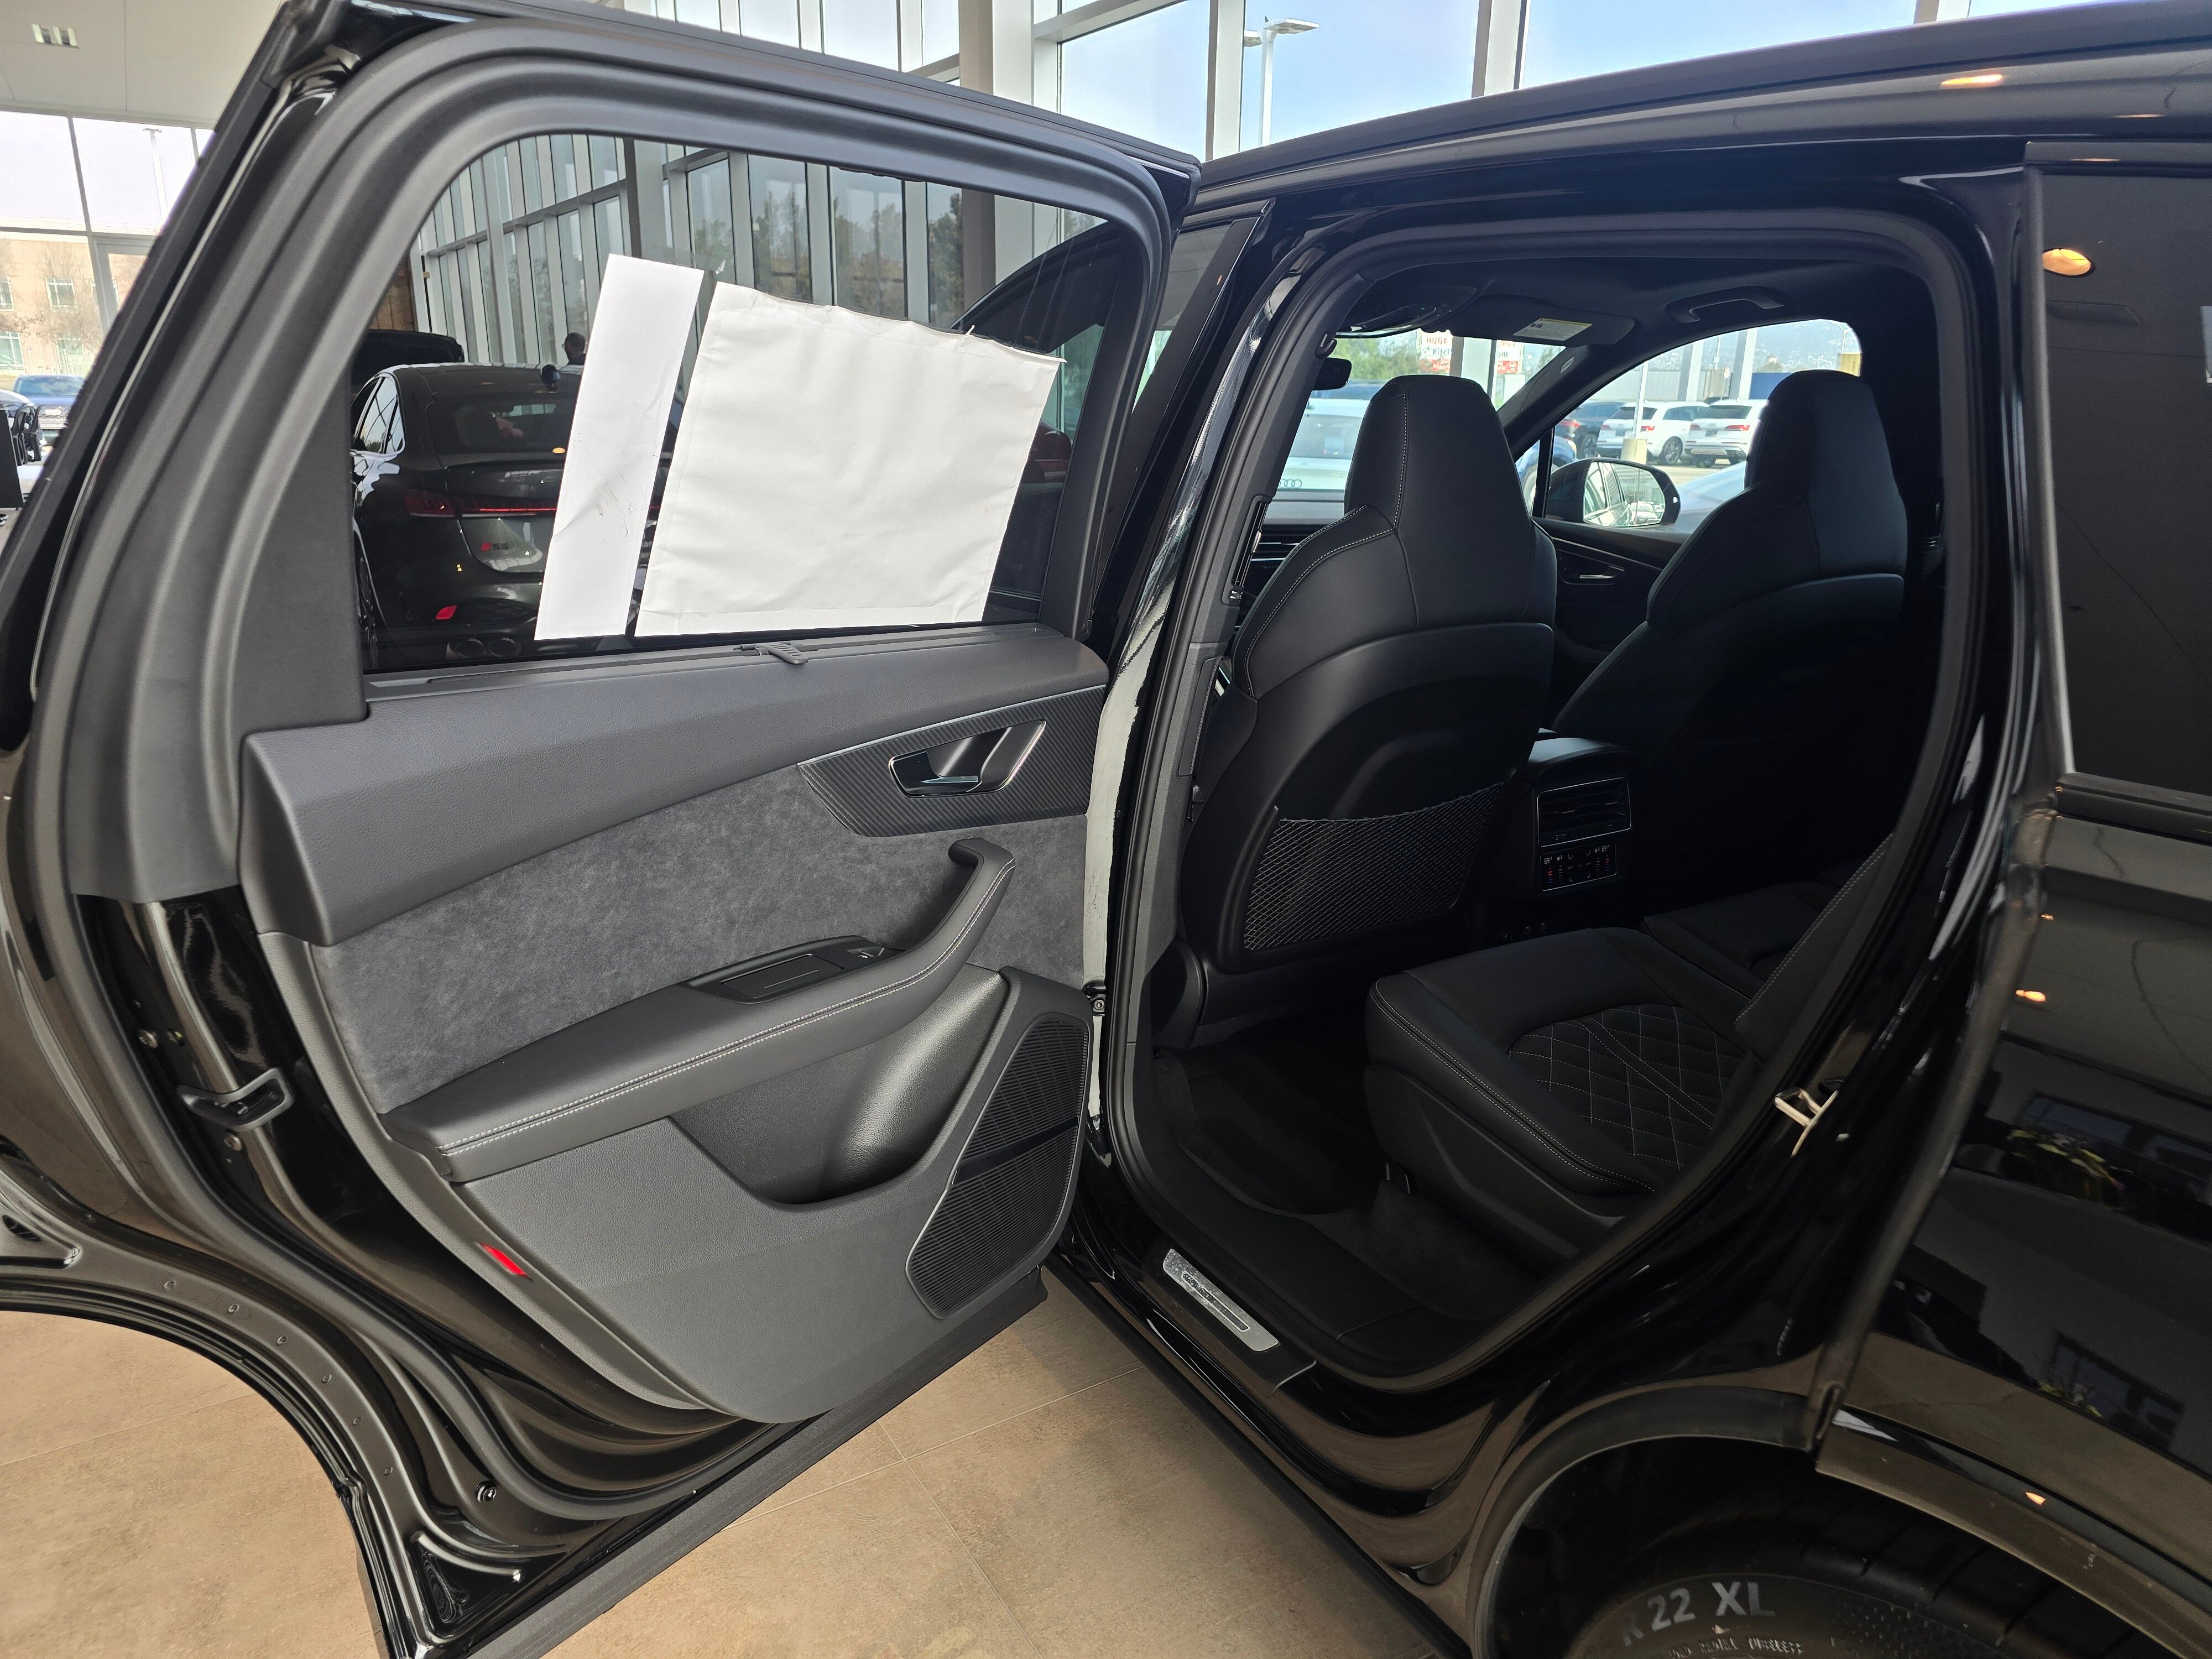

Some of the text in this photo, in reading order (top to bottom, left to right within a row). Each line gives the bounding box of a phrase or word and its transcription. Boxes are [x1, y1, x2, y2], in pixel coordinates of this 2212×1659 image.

[1426, 336, 1447, 345] HUGE
[1646, 1587, 1697, 1631] 22
[1711, 1581, 1776, 1617] XL
